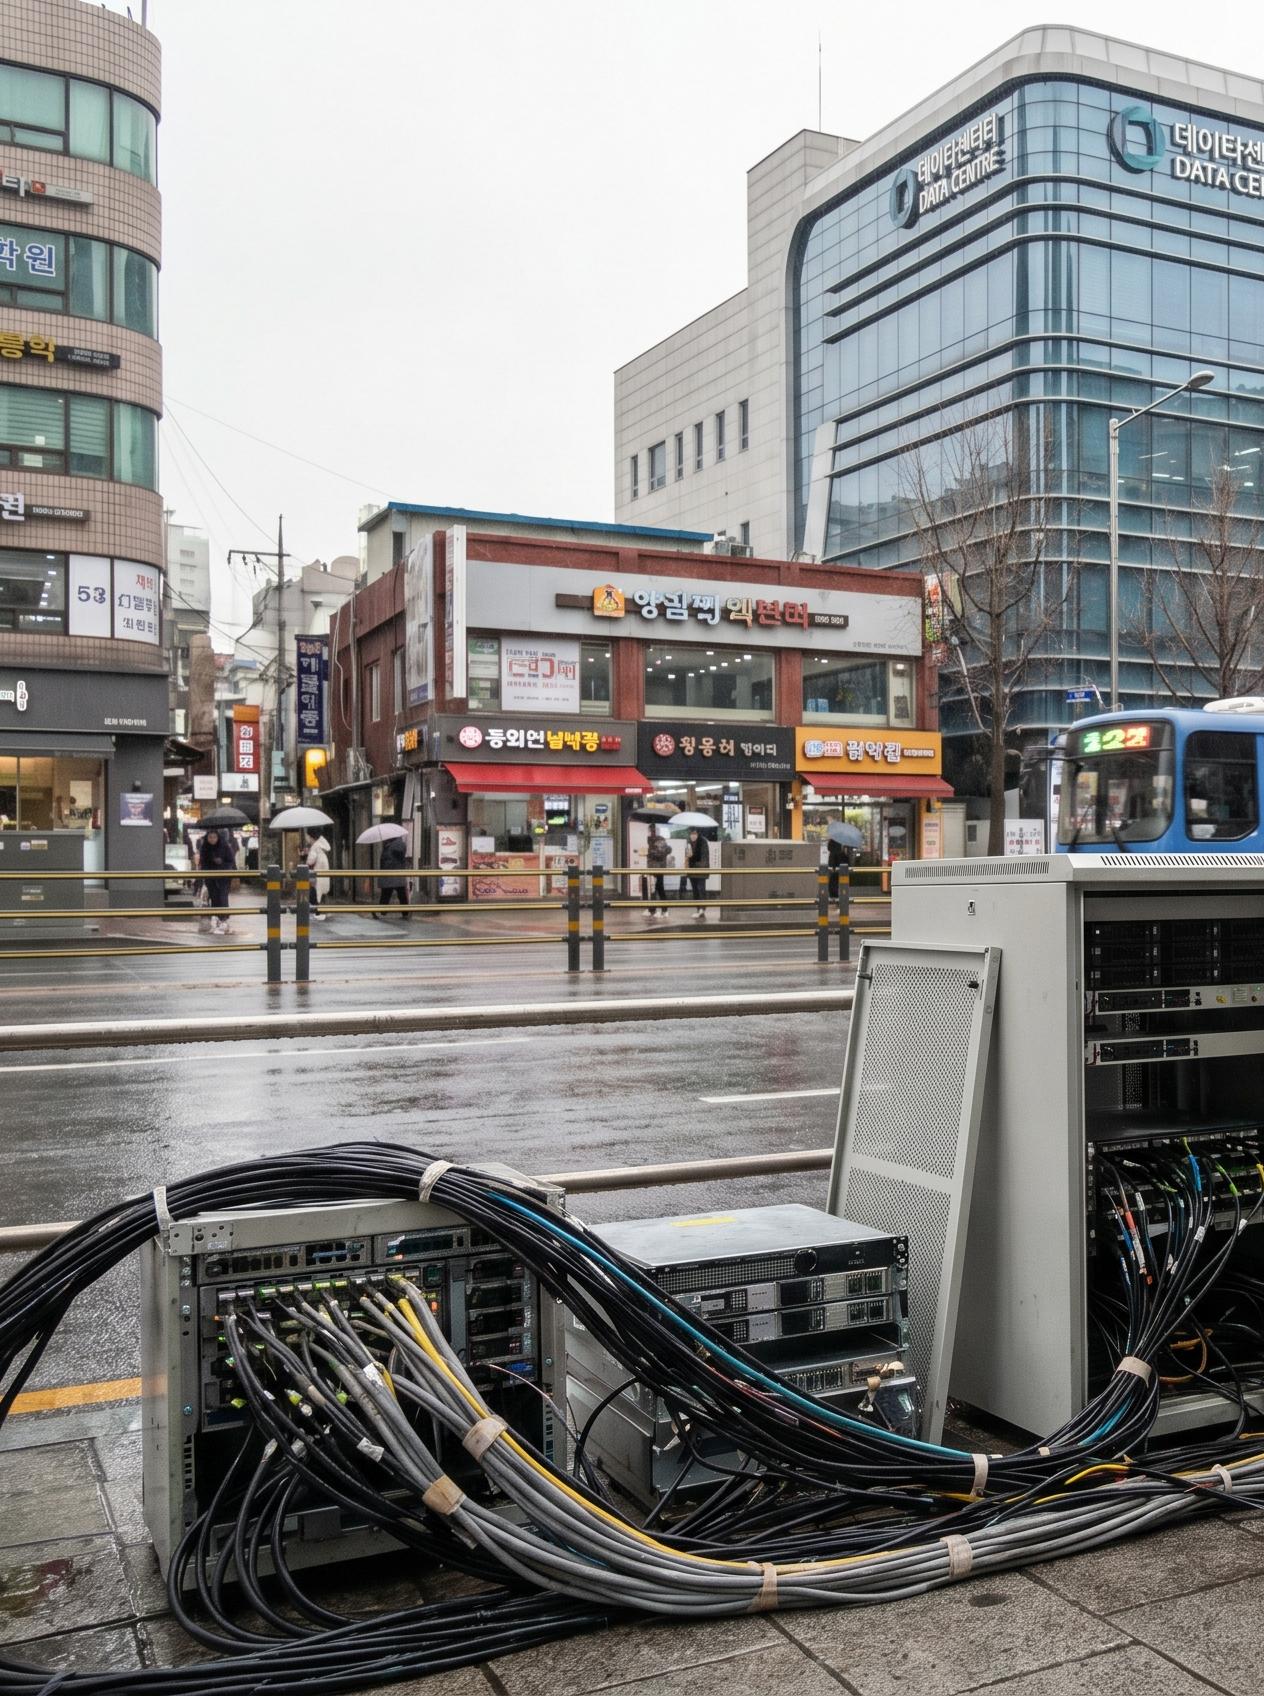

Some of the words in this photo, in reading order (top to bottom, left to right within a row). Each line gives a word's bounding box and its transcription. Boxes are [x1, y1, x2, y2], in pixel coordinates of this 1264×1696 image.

[919, 179, 949, 214] DATA
[951, 147, 1001, 193] CENTRE
[1174, 156, 1231, 189] DATA
